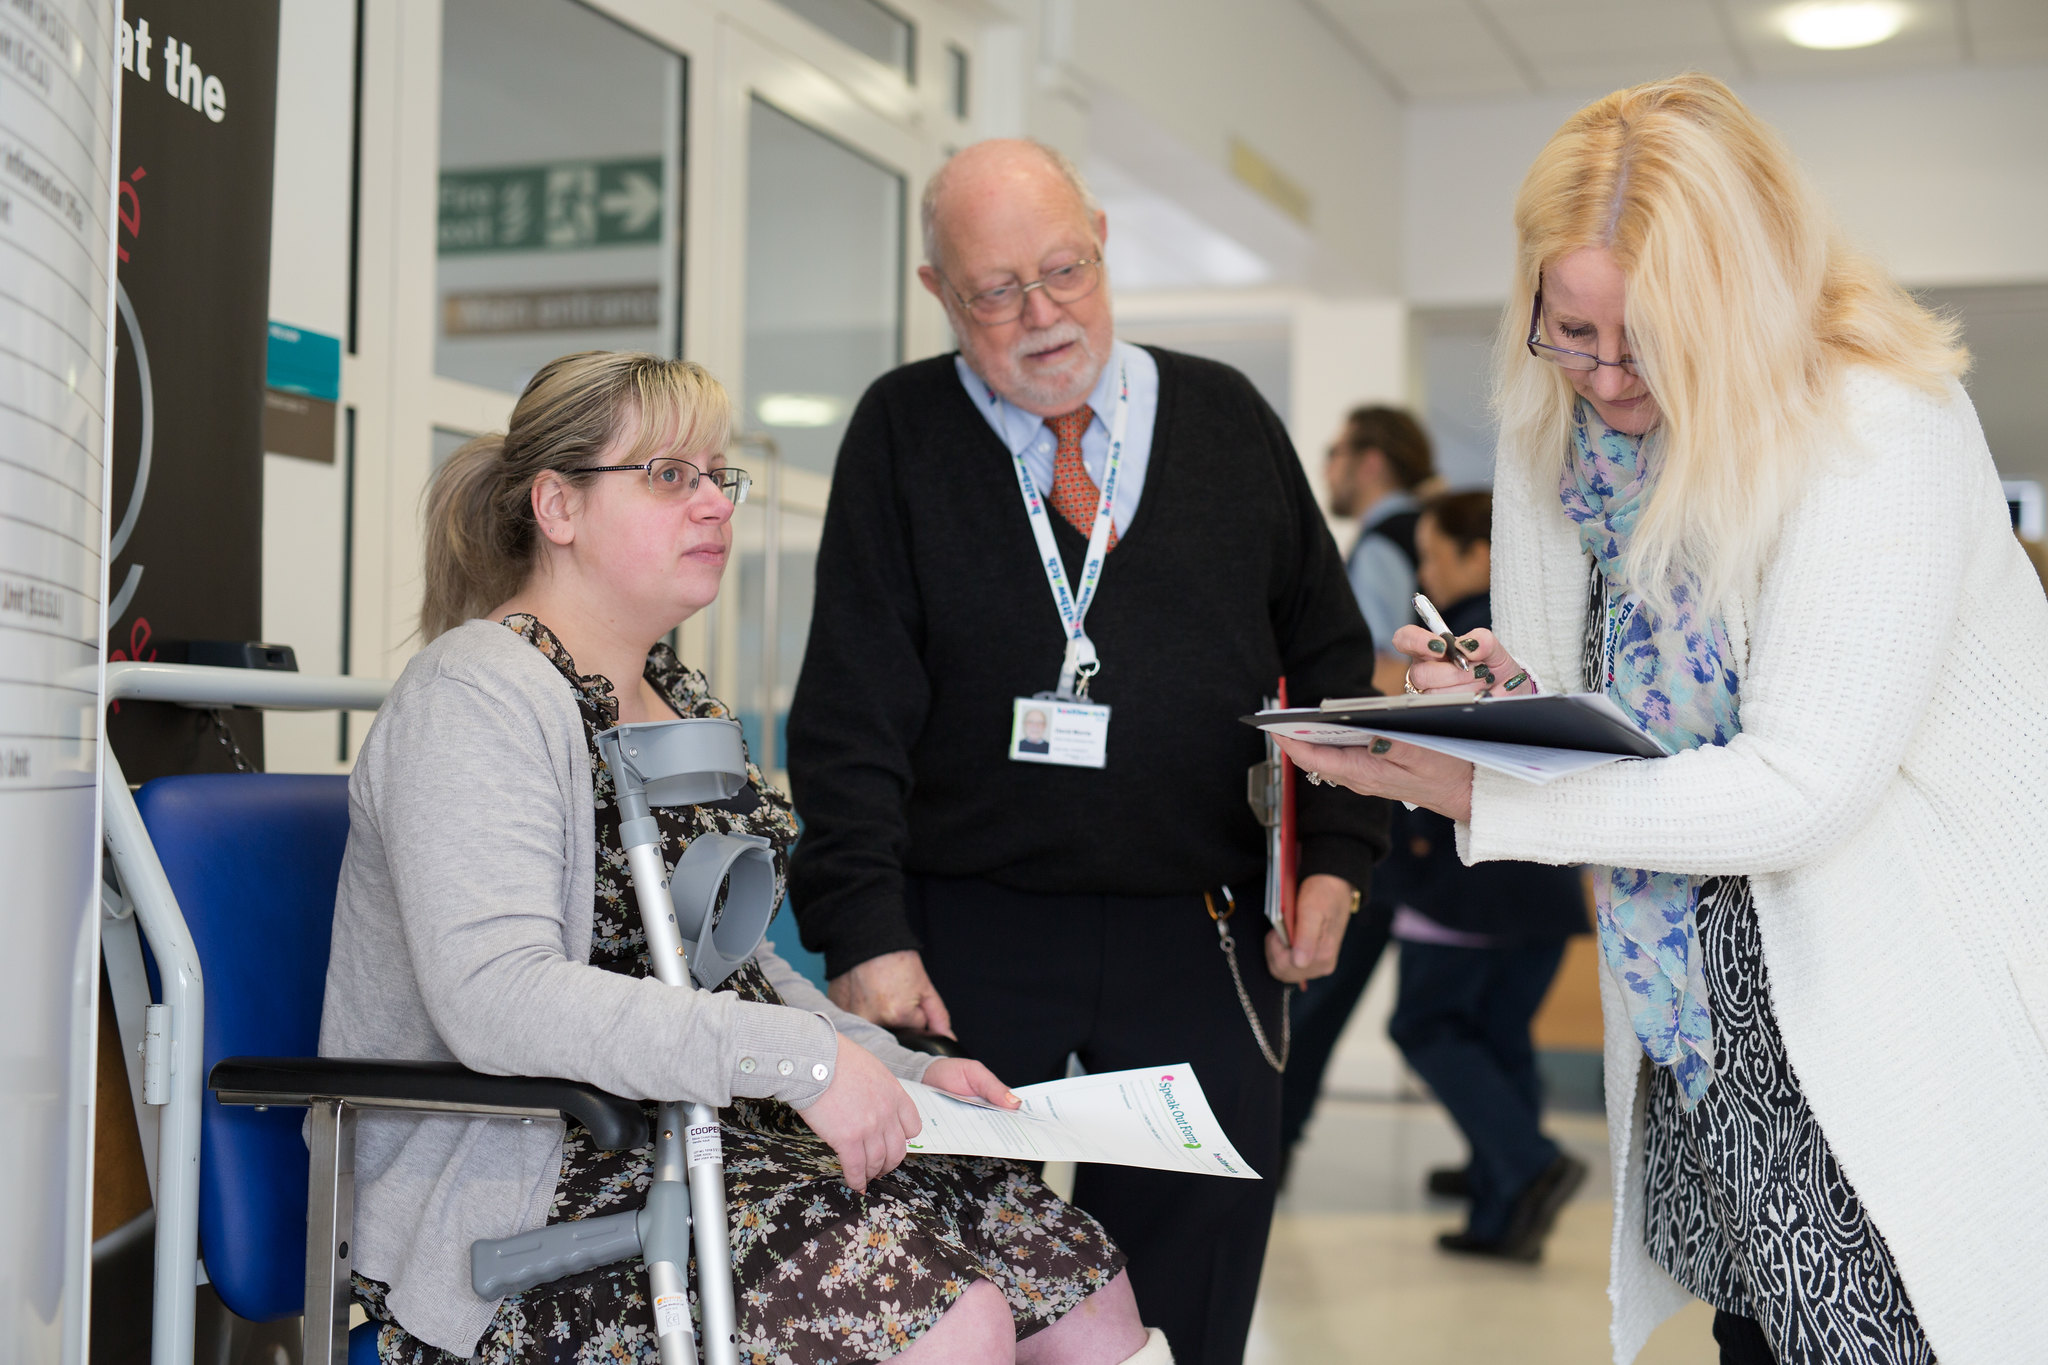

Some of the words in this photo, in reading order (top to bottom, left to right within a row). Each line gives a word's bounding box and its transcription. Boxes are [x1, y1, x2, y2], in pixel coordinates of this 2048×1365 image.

[164, 35, 226, 123] the
[1605, 601, 1635, 688] healthwatch
[1160, 1082, 1180, 1111] Speak
[1172, 1110, 1188, 1126] Out
[1180, 1125, 1198, 1144] Form
